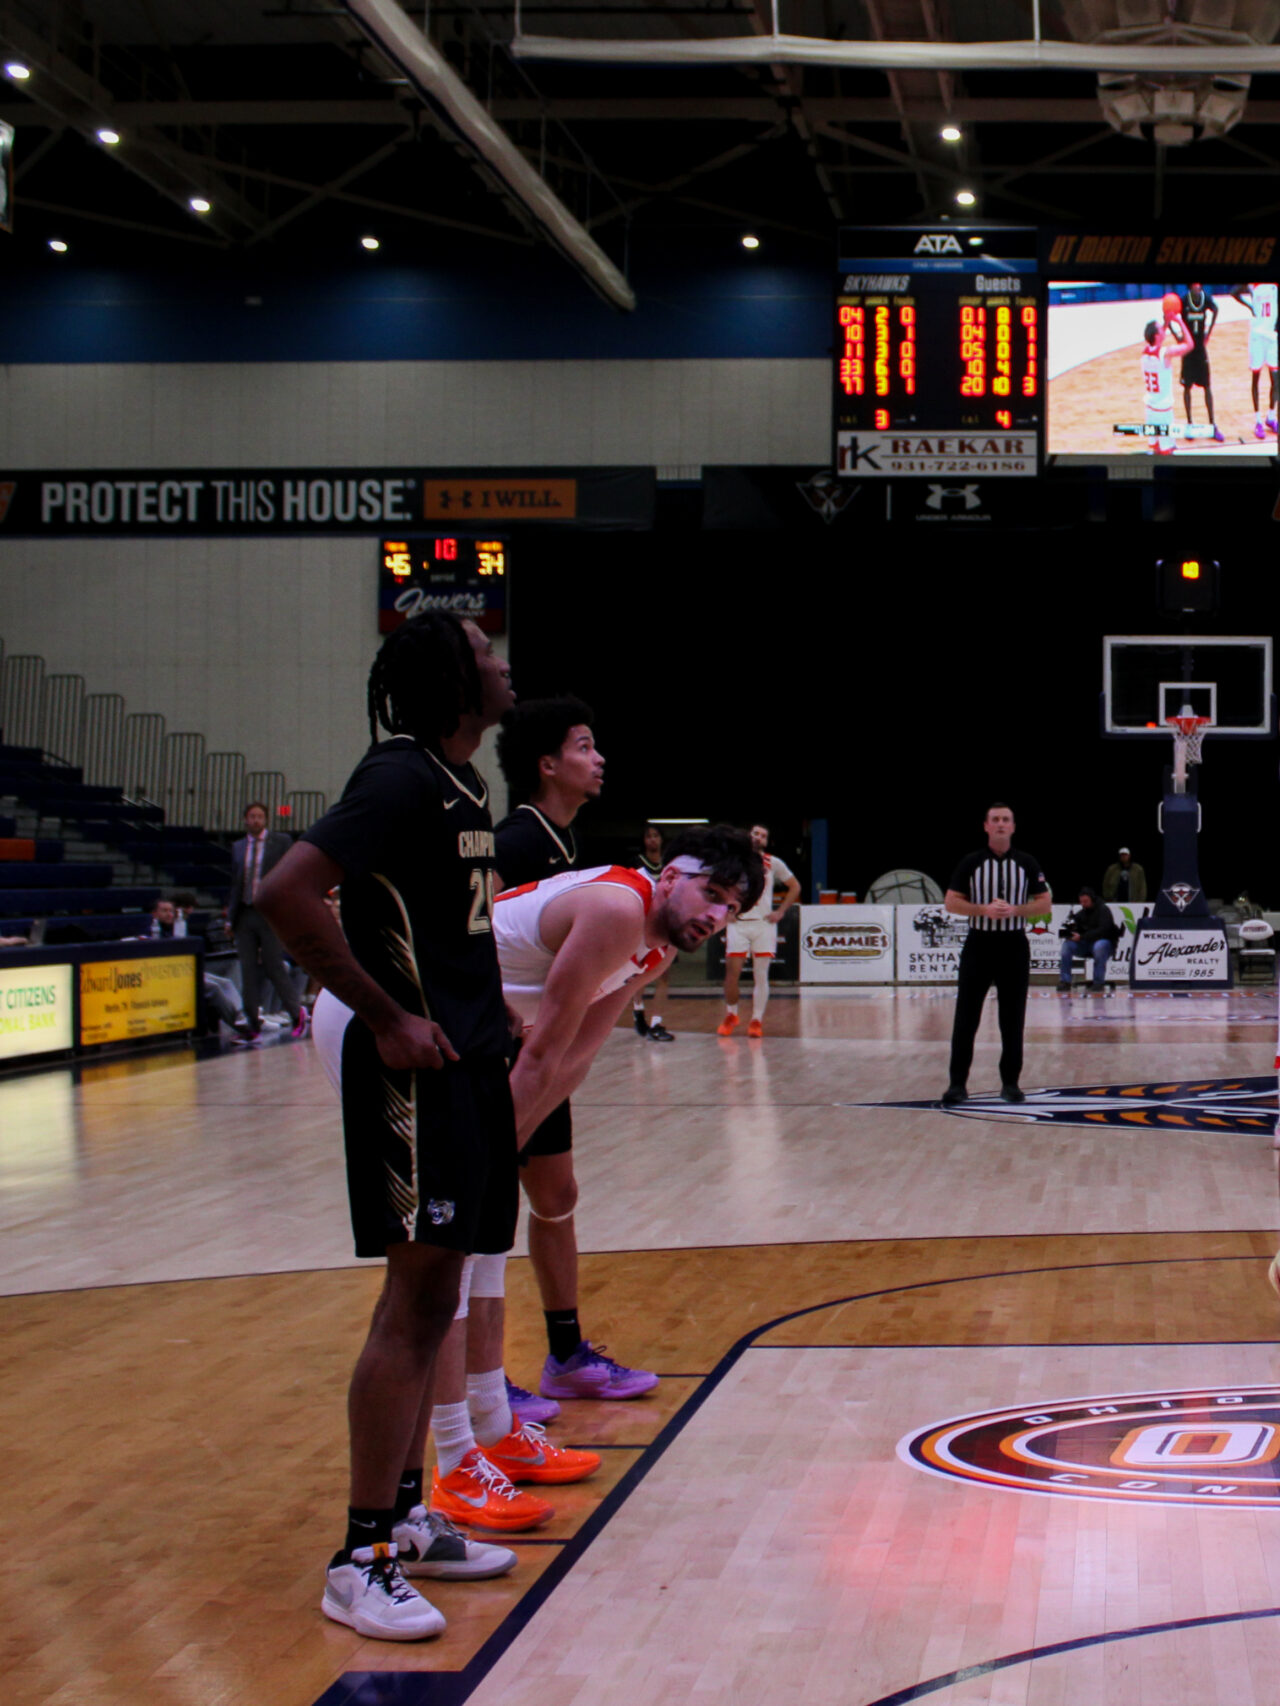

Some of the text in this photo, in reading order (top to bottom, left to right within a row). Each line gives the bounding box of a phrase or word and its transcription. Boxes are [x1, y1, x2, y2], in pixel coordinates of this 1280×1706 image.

[913, 235, 963, 254] ATA
[1050, 235, 1277, 264] UT MARTIN SKYHAWKS
[843, 275, 910, 292] SKYHAWKS
[975, 274, 1021, 292] Guests
[875, 408, 890, 430] 3
[994, 409, 1012, 430] 4
[891, 439, 1025, 454] RAEKAR
[41, 481, 204, 523] PROTECT
[210, 480, 275, 522] THIS
[478, 552, 504, 575] 34
[806, 935, 888, 949] SAMMIES
[1137, 937, 1226, 965] Alexander
[113, 967, 142, 993] Jones
[1188, 968, 1215, 978] 1985
[6, 985, 56, 1009] CITIZENS
[1024, 1396, 1244, 1426] OHIO
